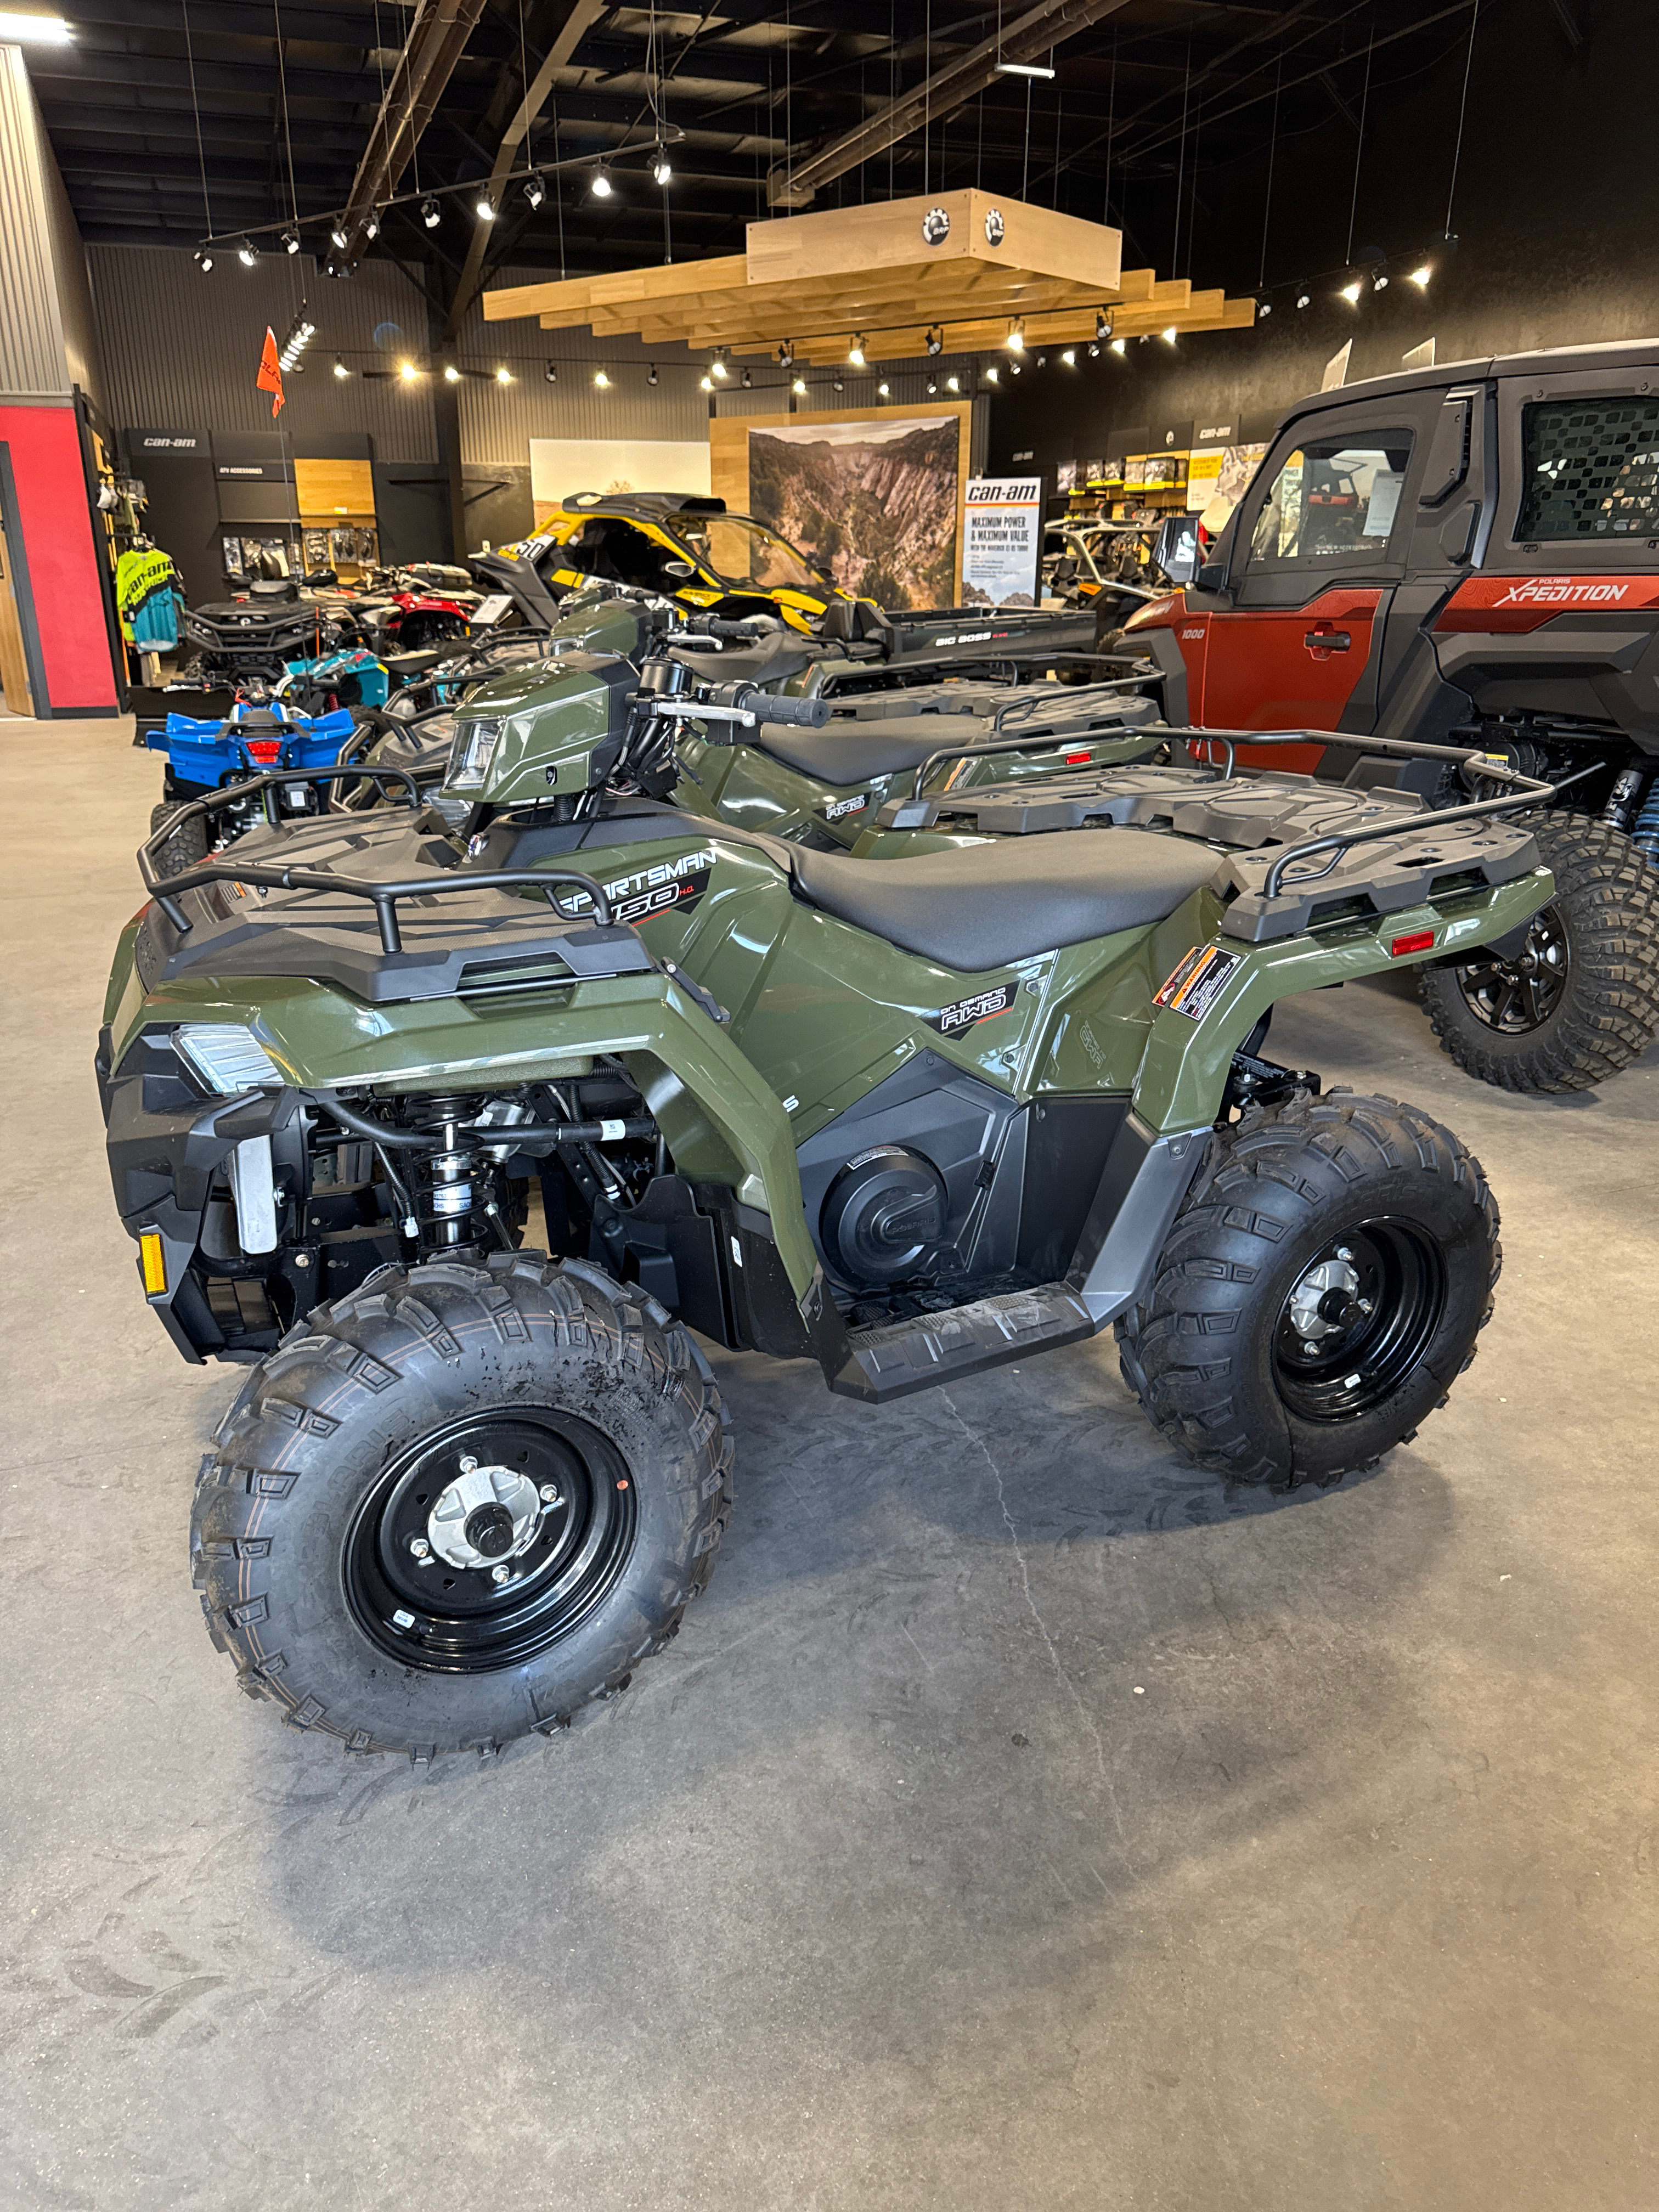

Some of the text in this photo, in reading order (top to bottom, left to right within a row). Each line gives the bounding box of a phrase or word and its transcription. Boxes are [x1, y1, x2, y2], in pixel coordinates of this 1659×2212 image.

[933, 226, 950, 235] BRP
[144, 437, 196, 447] can-am
[968, 485, 1036, 501] can-am
[972, 516, 1026, 528] MAXIMUM POWER
[978, 530, 1008, 541] MAXIMUM
[1010, 530, 1029, 541] VALUE
[1492, 579, 1629, 607] XPEDITION
[935, 636, 956, 647] BIG
[958, 631, 991, 644] BOSS
[1182, 629, 1205, 639] 1000
[826, 799, 865, 820] AWD
[611, 883, 680, 921] 50
[1186, 961, 1206, 988] WARNING
[940, 987, 1006, 1015] ON DEMAND
[941, 994, 1006, 1030] AWD
[891, 1216, 936, 1234] POLARIS
